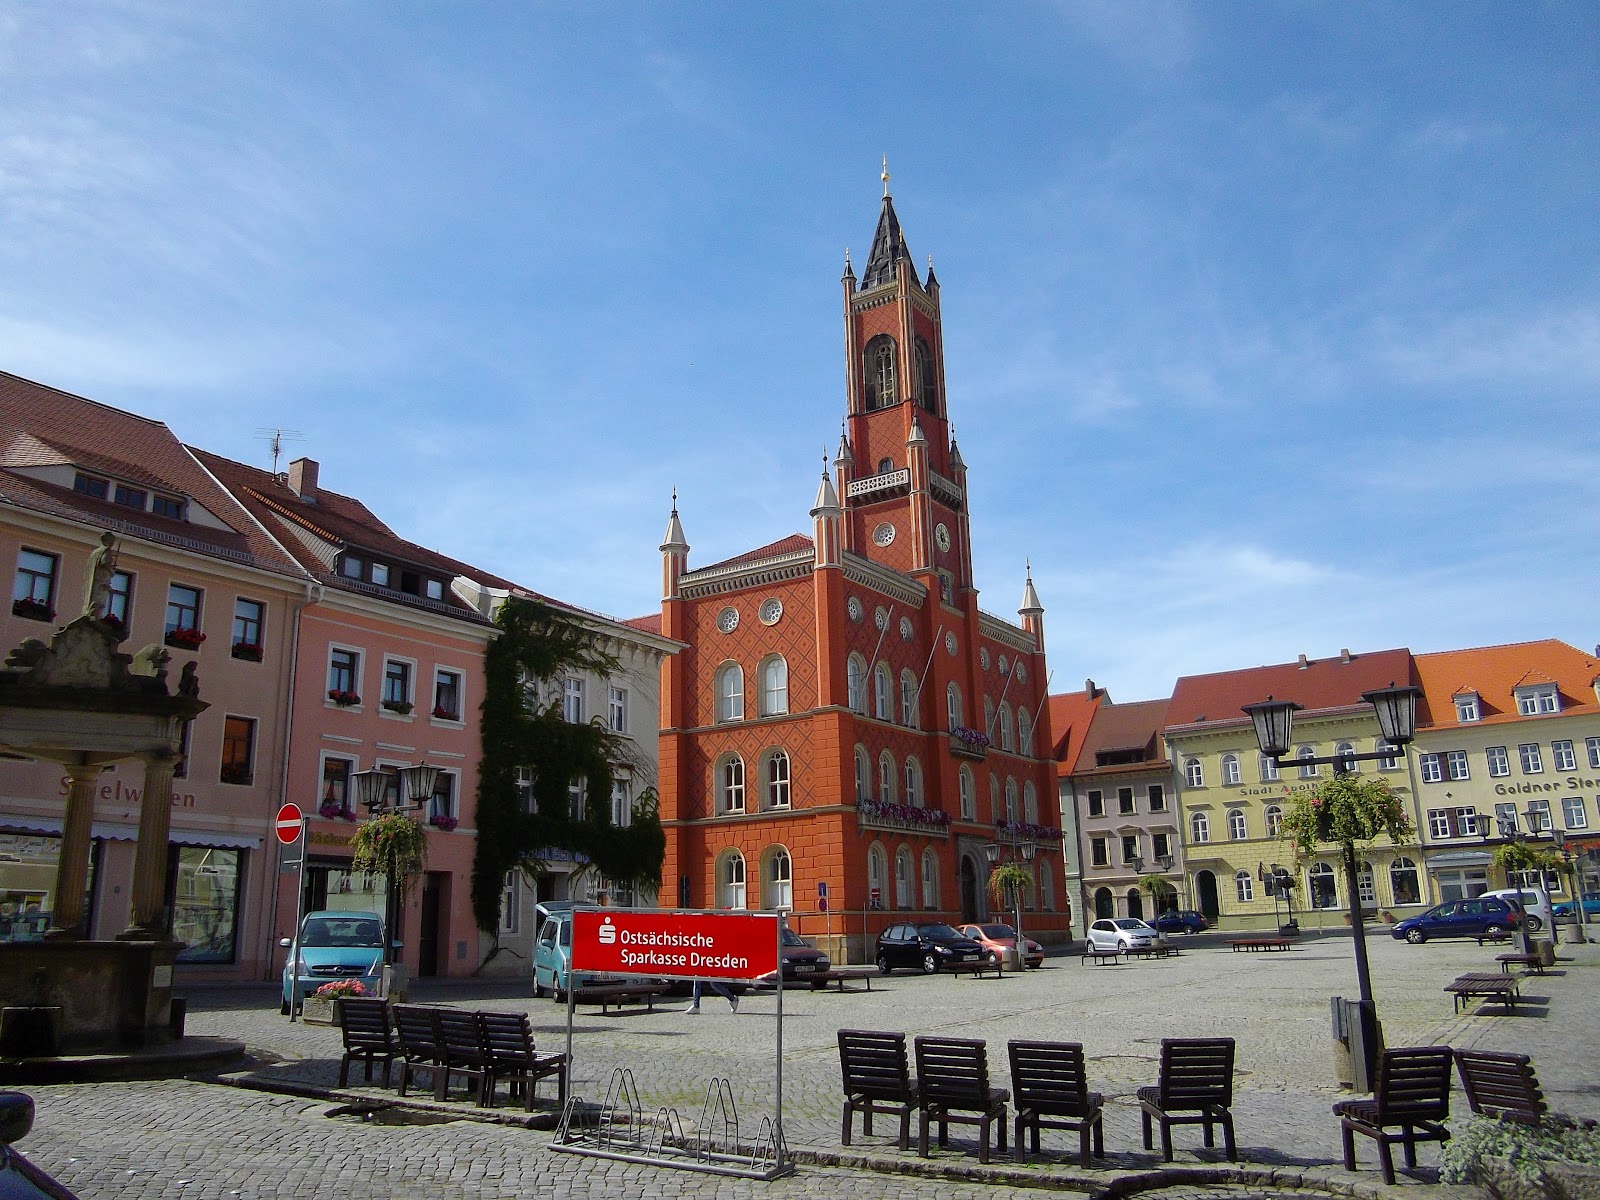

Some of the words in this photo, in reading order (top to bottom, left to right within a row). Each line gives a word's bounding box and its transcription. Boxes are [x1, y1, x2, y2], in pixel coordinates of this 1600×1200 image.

[1494, 781, 1561, 795] Goldner
[620, 929, 714, 948] Ostsächsische
[620, 949, 686, 966] Sparkasse
[690, 952, 748, 969] Dresden
